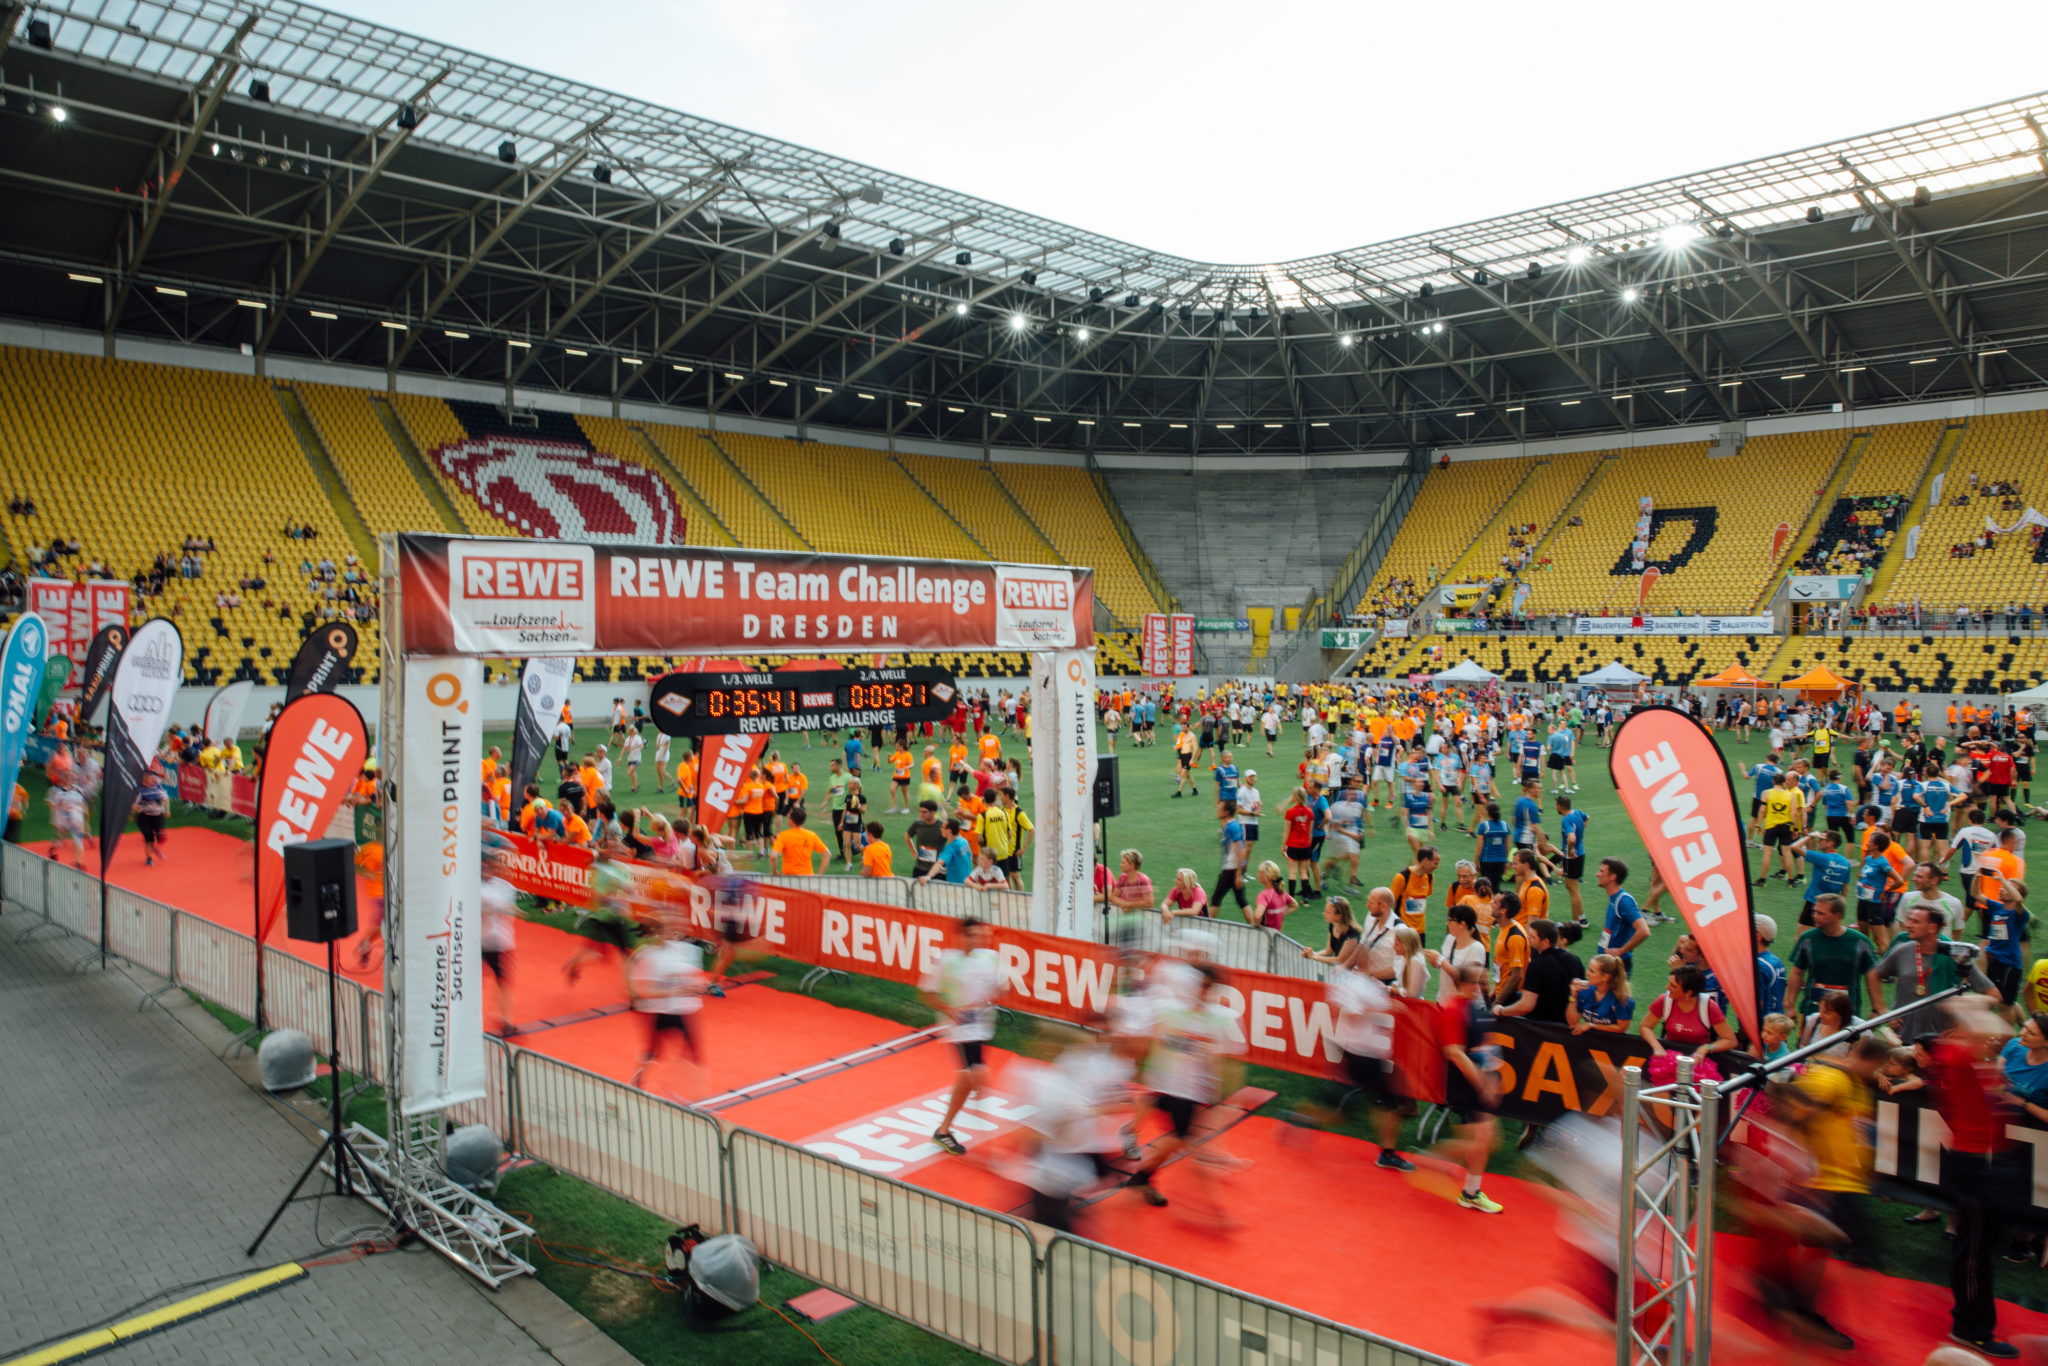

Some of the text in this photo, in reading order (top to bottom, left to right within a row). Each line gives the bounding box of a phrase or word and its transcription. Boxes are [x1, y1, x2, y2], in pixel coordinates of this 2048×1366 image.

[467, 559, 580, 597] REWE
[610, 556, 985, 614] REWE Team Challenge
[1004, 580, 1067, 608] REWE
[743, 614, 897, 639] DRESDEN
[1153, 619, 1168, 674] REWE
[1174, 619, 1190, 674] REWE
[5, 661, 33, 733] OKAL
[744, 674, 774, 685] WELLE
[850, 683, 926, 709] 0:05:21
[880, 669, 907, 680] WELLE
[709, 689, 796, 717] 0:35:41
[739, 709, 896, 734] REWE TEAM CHALLENGE
[803, 693, 833, 707] REWE
[1075, 691, 1087, 797] SAXOPRINT
[267, 717, 354, 858] REWE
[705, 734, 753, 814] REW
[442, 720, 462, 877] SAXOPRINT
[821, 908, 943, 975] REWE
